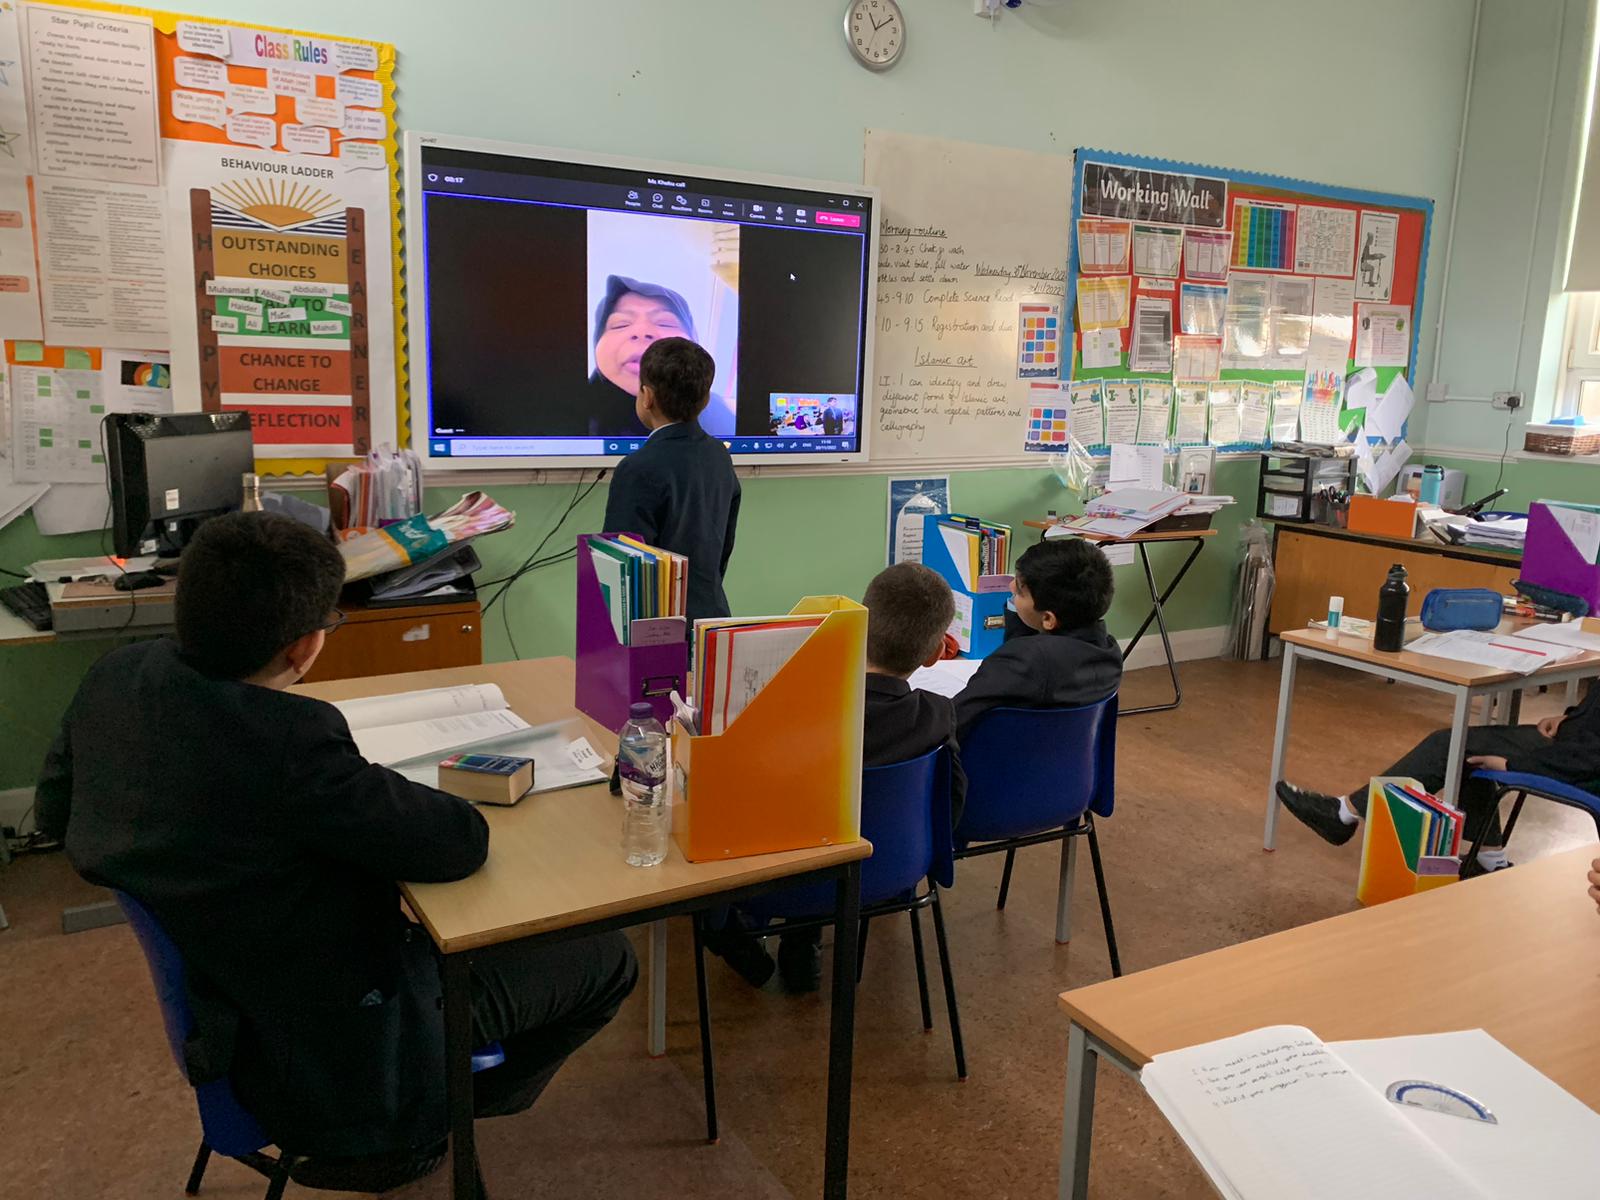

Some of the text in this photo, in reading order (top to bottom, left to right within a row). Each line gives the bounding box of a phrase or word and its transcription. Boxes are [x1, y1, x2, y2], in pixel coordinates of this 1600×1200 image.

[51, 15, 129, 34] Star Pupil Criteria
[254, 33, 290, 61] Class
[293, 39, 329, 65] Rules
[220, 157, 335, 180] BEHAVIOUR LADDER
[1100, 178, 1211, 212] Working Wall
[880, 218, 911, 243] Morning
[221, 235, 340, 258] OUTSTANDING
[248, 262, 317, 280] CHOICES
[303, 298, 325, 313] TO
[922, 288, 960, 309] Complete
[964, 290, 991, 304] Science
[259, 322, 311, 335] EARN
[931, 315, 980, 341] Registration
[239, 352, 332, 369] CHANCE TO
[253, 377, 321, 392] CHANGE
[909, 379, 923, 387] can
[928, 376, 961, 397] identify
[967, 375, 982, 387] and
[250, 412, 341, 428] EFLECTION
[880, 404, 919, 423] geometric
[975, 404, 1006, 421] patterns
[1007, 407, 1022, 417] and
